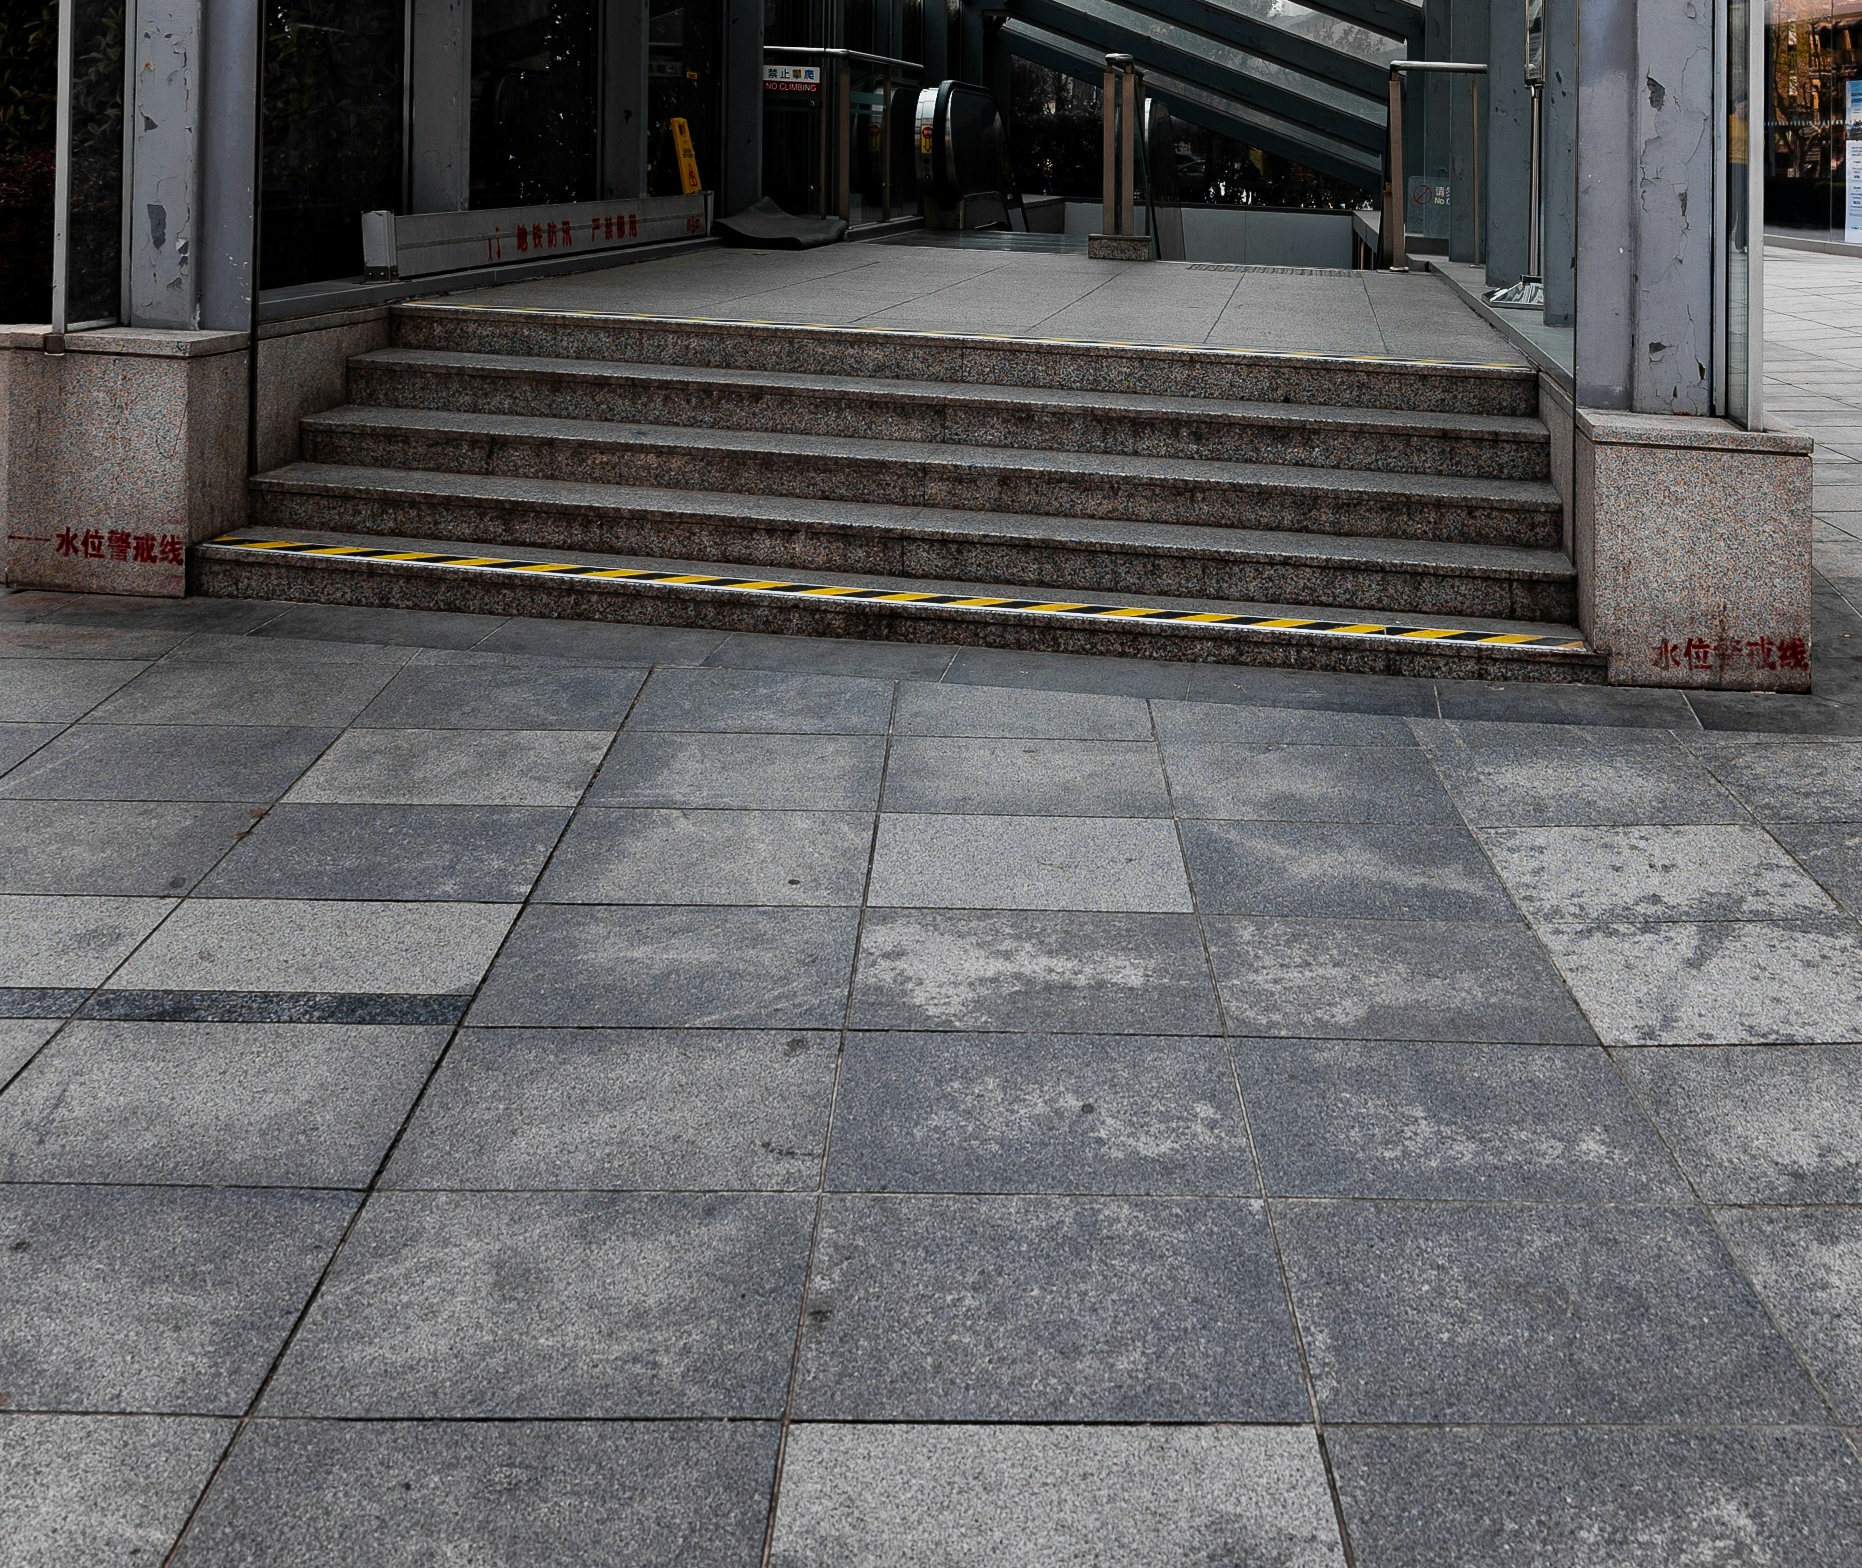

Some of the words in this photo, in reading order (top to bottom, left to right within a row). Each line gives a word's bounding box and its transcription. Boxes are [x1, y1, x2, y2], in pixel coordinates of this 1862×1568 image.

[767, 68, 815, 81] 禁止攀爬
[765, 82, 778, 91] NO
[779, 82, 817, 92] CLIMBING
[55, 525, 184, 565] 水位警戒线
